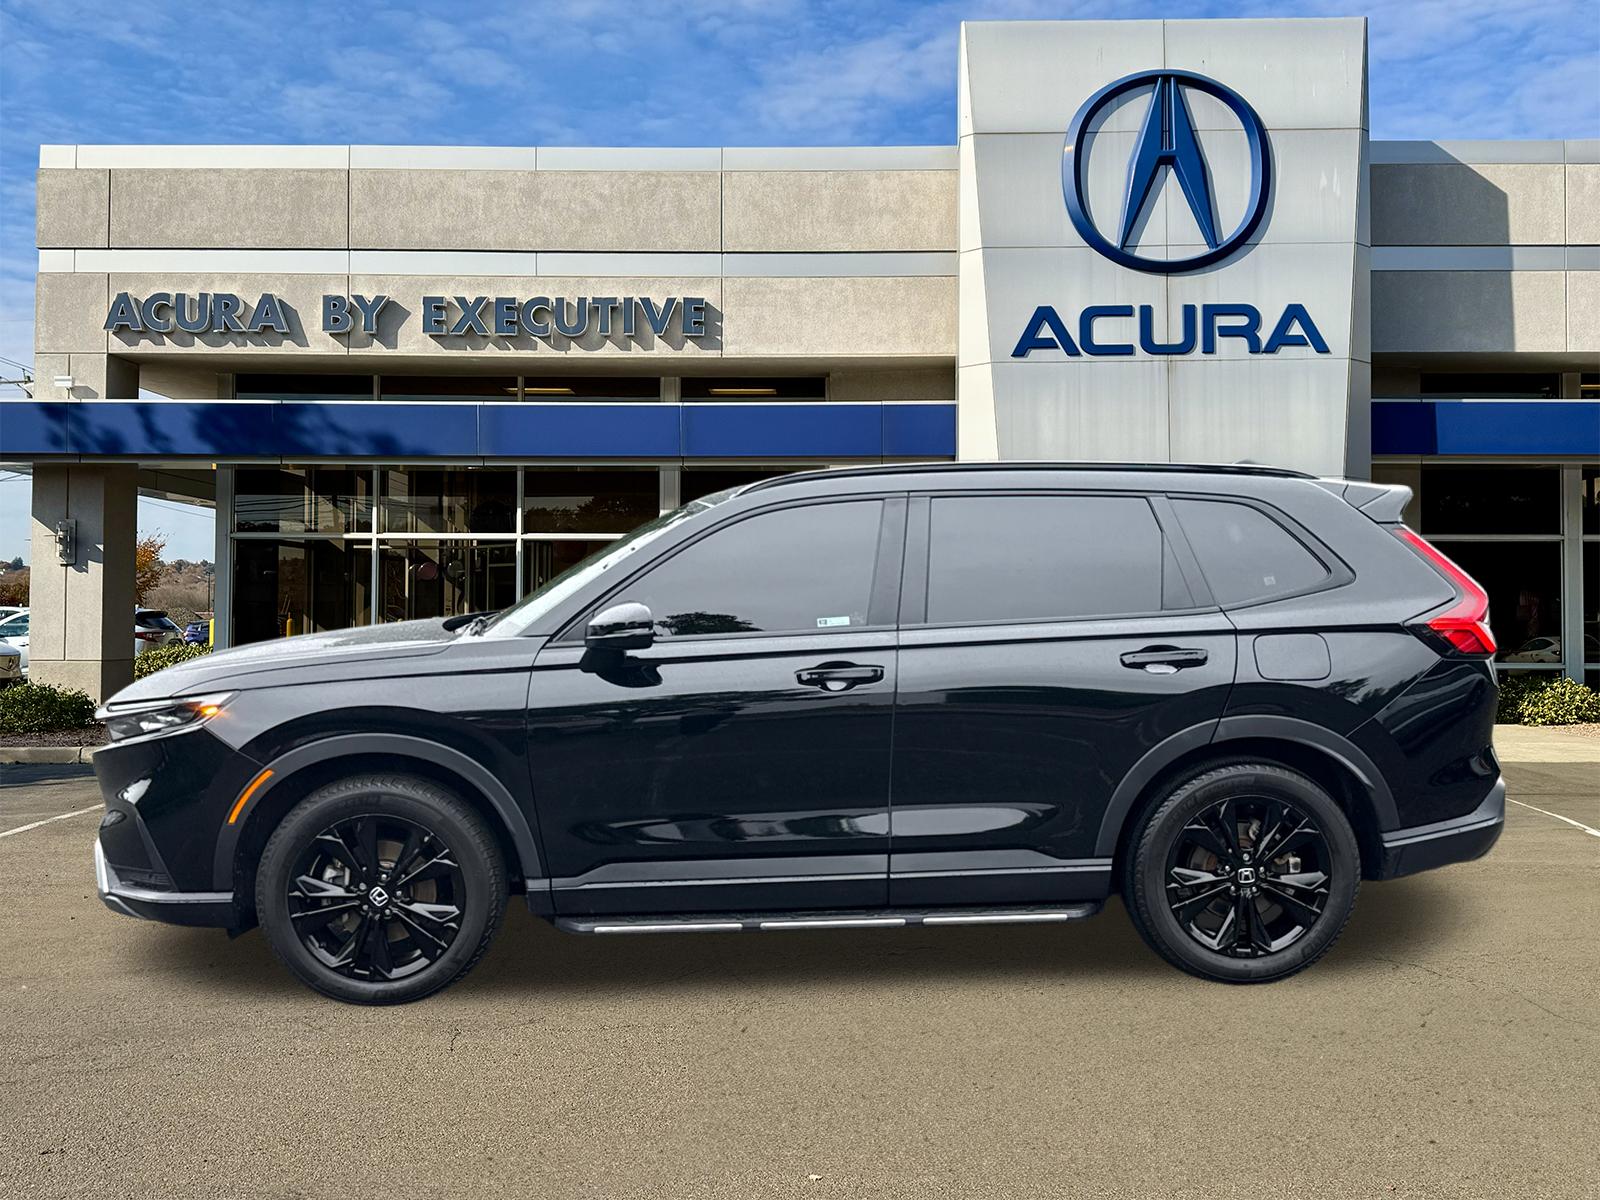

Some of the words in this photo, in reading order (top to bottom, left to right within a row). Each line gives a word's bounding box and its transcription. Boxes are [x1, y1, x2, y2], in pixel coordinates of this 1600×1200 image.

[104, 291, 291, 334] ACURA
[321, 294, 390, 335] BY
[421, 296, 708, 337] EXECUTIVE
[1011, 303, 1332, 357] ACURA
